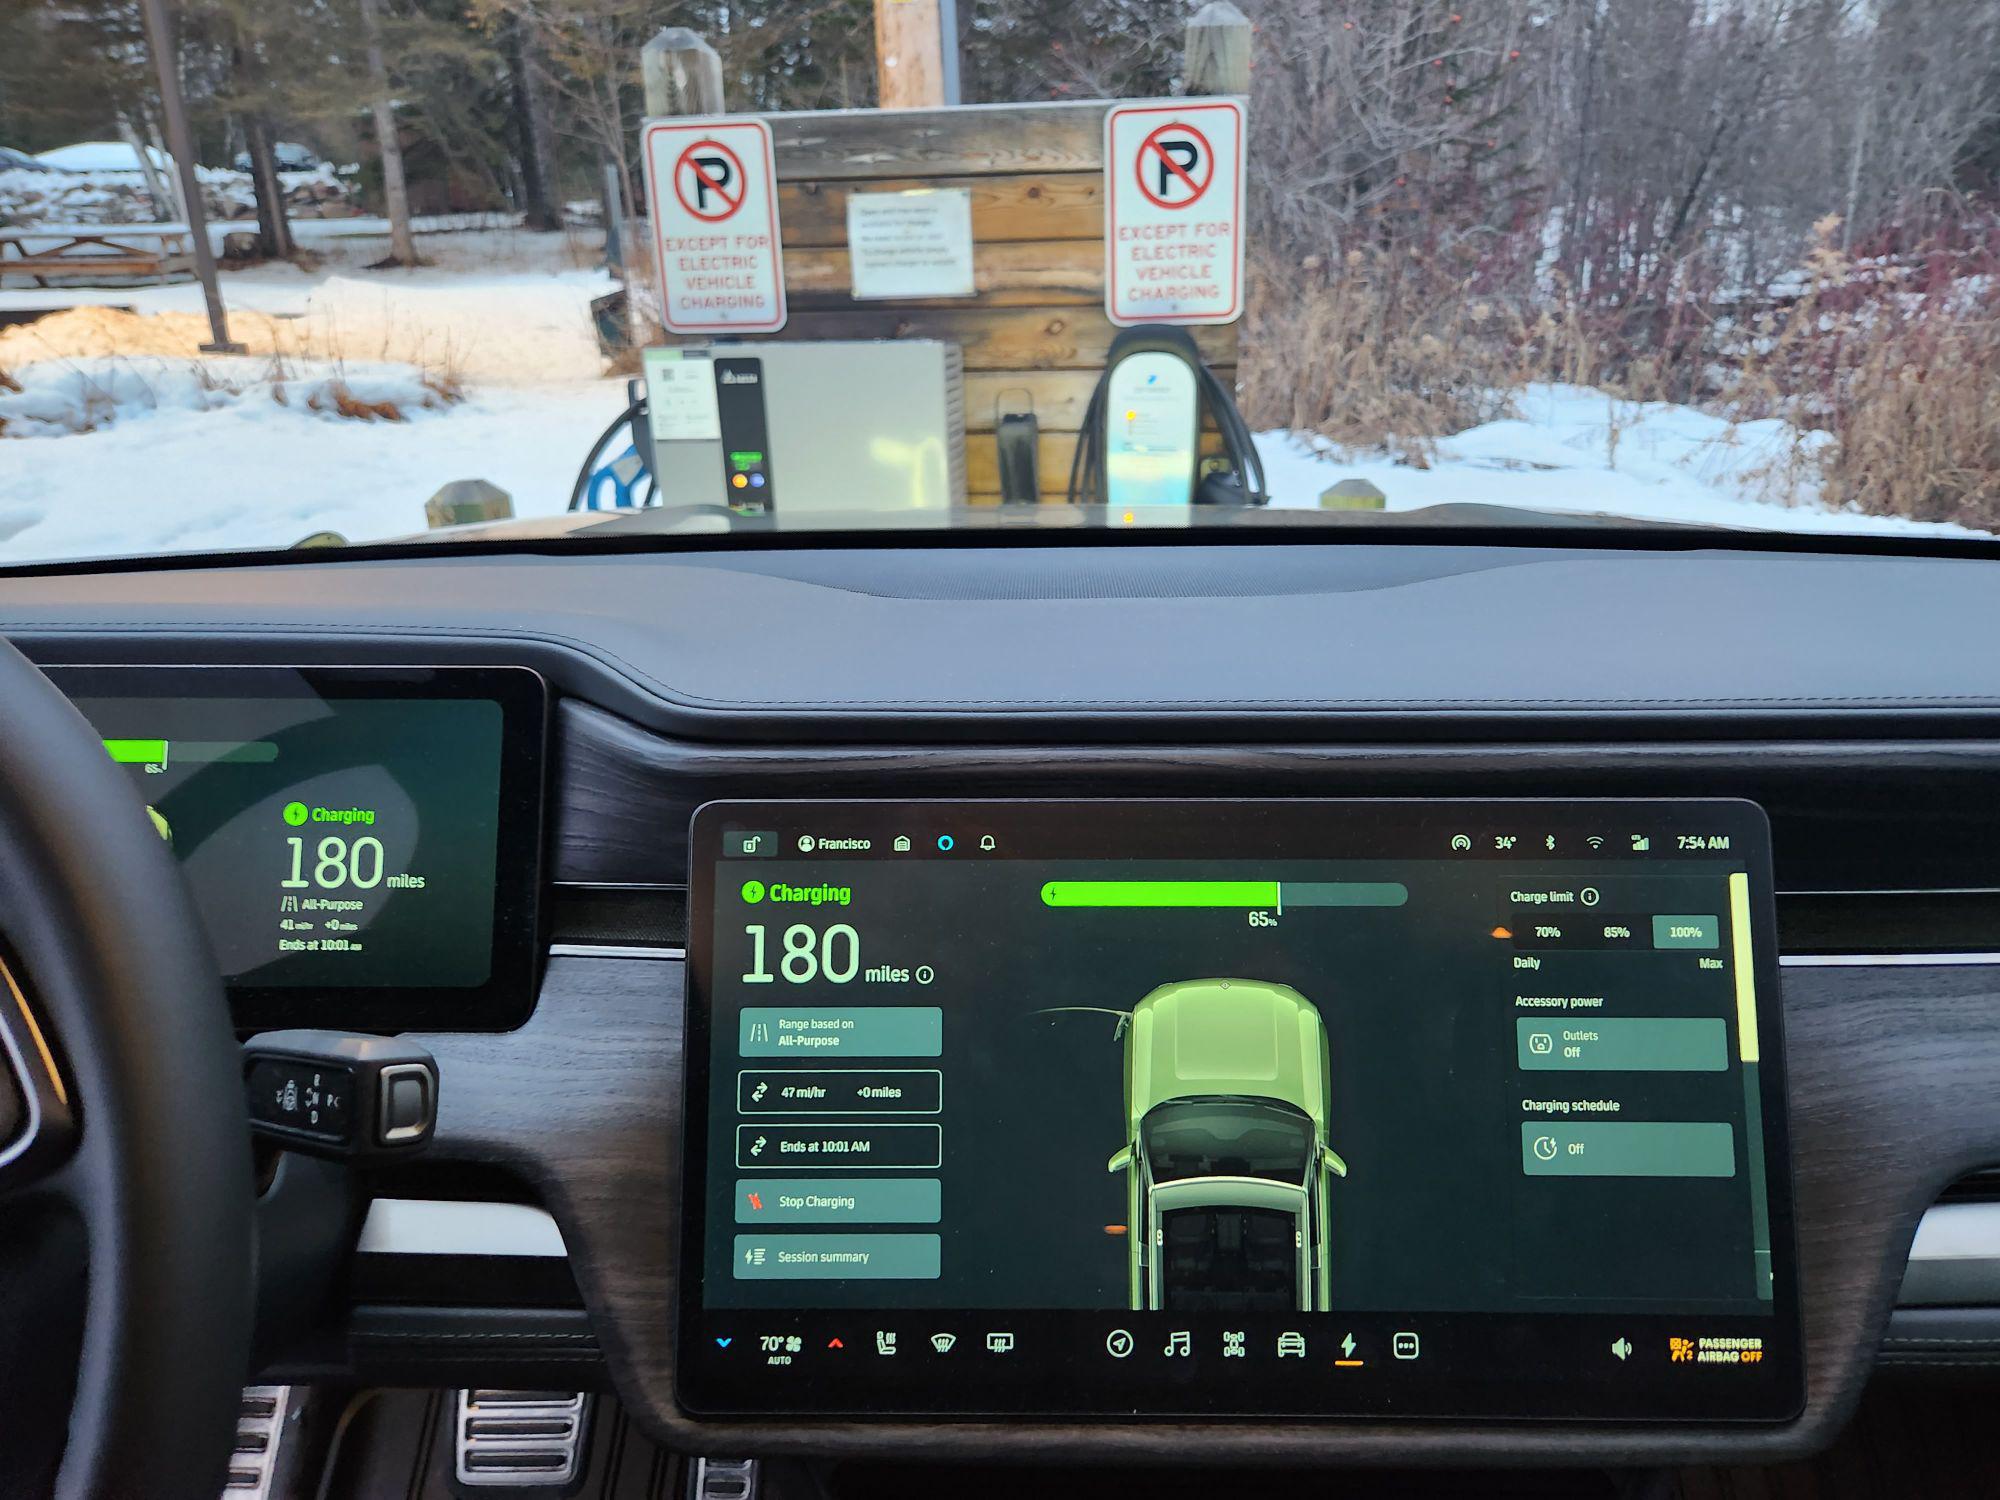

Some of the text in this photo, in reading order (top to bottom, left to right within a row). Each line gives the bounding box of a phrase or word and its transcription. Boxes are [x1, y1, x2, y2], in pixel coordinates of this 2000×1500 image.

[1119, 223, 1231, 241] EXCEPT FOR
[665, 235, 769, 252] EXCEPT FOR
[1131, 244, 1217, 261] ELECTRIC
[679, 256, 758, 271] ELECTRIC
[1135, 265, 1213, 281] VEHICLE
[685, 276, 756, 291] VEHICLE
[1127, 285, 1220, 301] CHARGING
[681, 297, 765, 311] CHARGING
[311, 807, 375, 825] Charging
[818, 837, 871, 850] Francisco
[1494, 836, 1517, 850] 34°
[1676, 835, 1730, 850] 7:54 AM
[280, 836, 426, 889] 180 miles
[769, 882, 851, 906] Charging
[1510, 890, 1575, 904] Charge limit
[301, 898, 364, 913] All-Purpose
[1248, 911, 1278, 927] 65%
[1534, 926, 1561, 938] 70%
[1603, 926, 1631, 938] 85%
[1670, 926, 1703, 938] 100%
[278, 938, 306, 951] Ends
[306, 939, 319, 951] at
[320, 939, 350, 951] 10:01
[742, 923, 910, 984] 180 miles
[1513, 956, 1541, 971] Daily
[1698, 957, 1724, 969] Max
[1515, 995, 1604, 1010] Accessory power
[778, 1018, 855, 1031] Range based on
[777, 1034, 840, 1049] All-Purpose
[1562, 1030, 1599, 1041] Outlets
[1563, 1046, 1582, 1058] Off
[780, 1085, 827, 1099] 47 mi/hr
[856, 1086, 902, 1099] +0 miles
[1521, 1099, 1621, 1114] Charging schedule
[780, 1140, 871, 1153] Ends at 10:01 AM
[1567, 1143, 1585, 1155] Off
[779, 1195, 855, 1210] Stop Charging
[777, 1250, 870, 1265] Session summary
[759, 1335, 785, 1352] 70°
[1698, 1338, 1763, 1350] PASSENGER
[767, 1355, 792, 1366] AUTO
[1697, 1351, 1763, 1362] AIRBAG OFF
